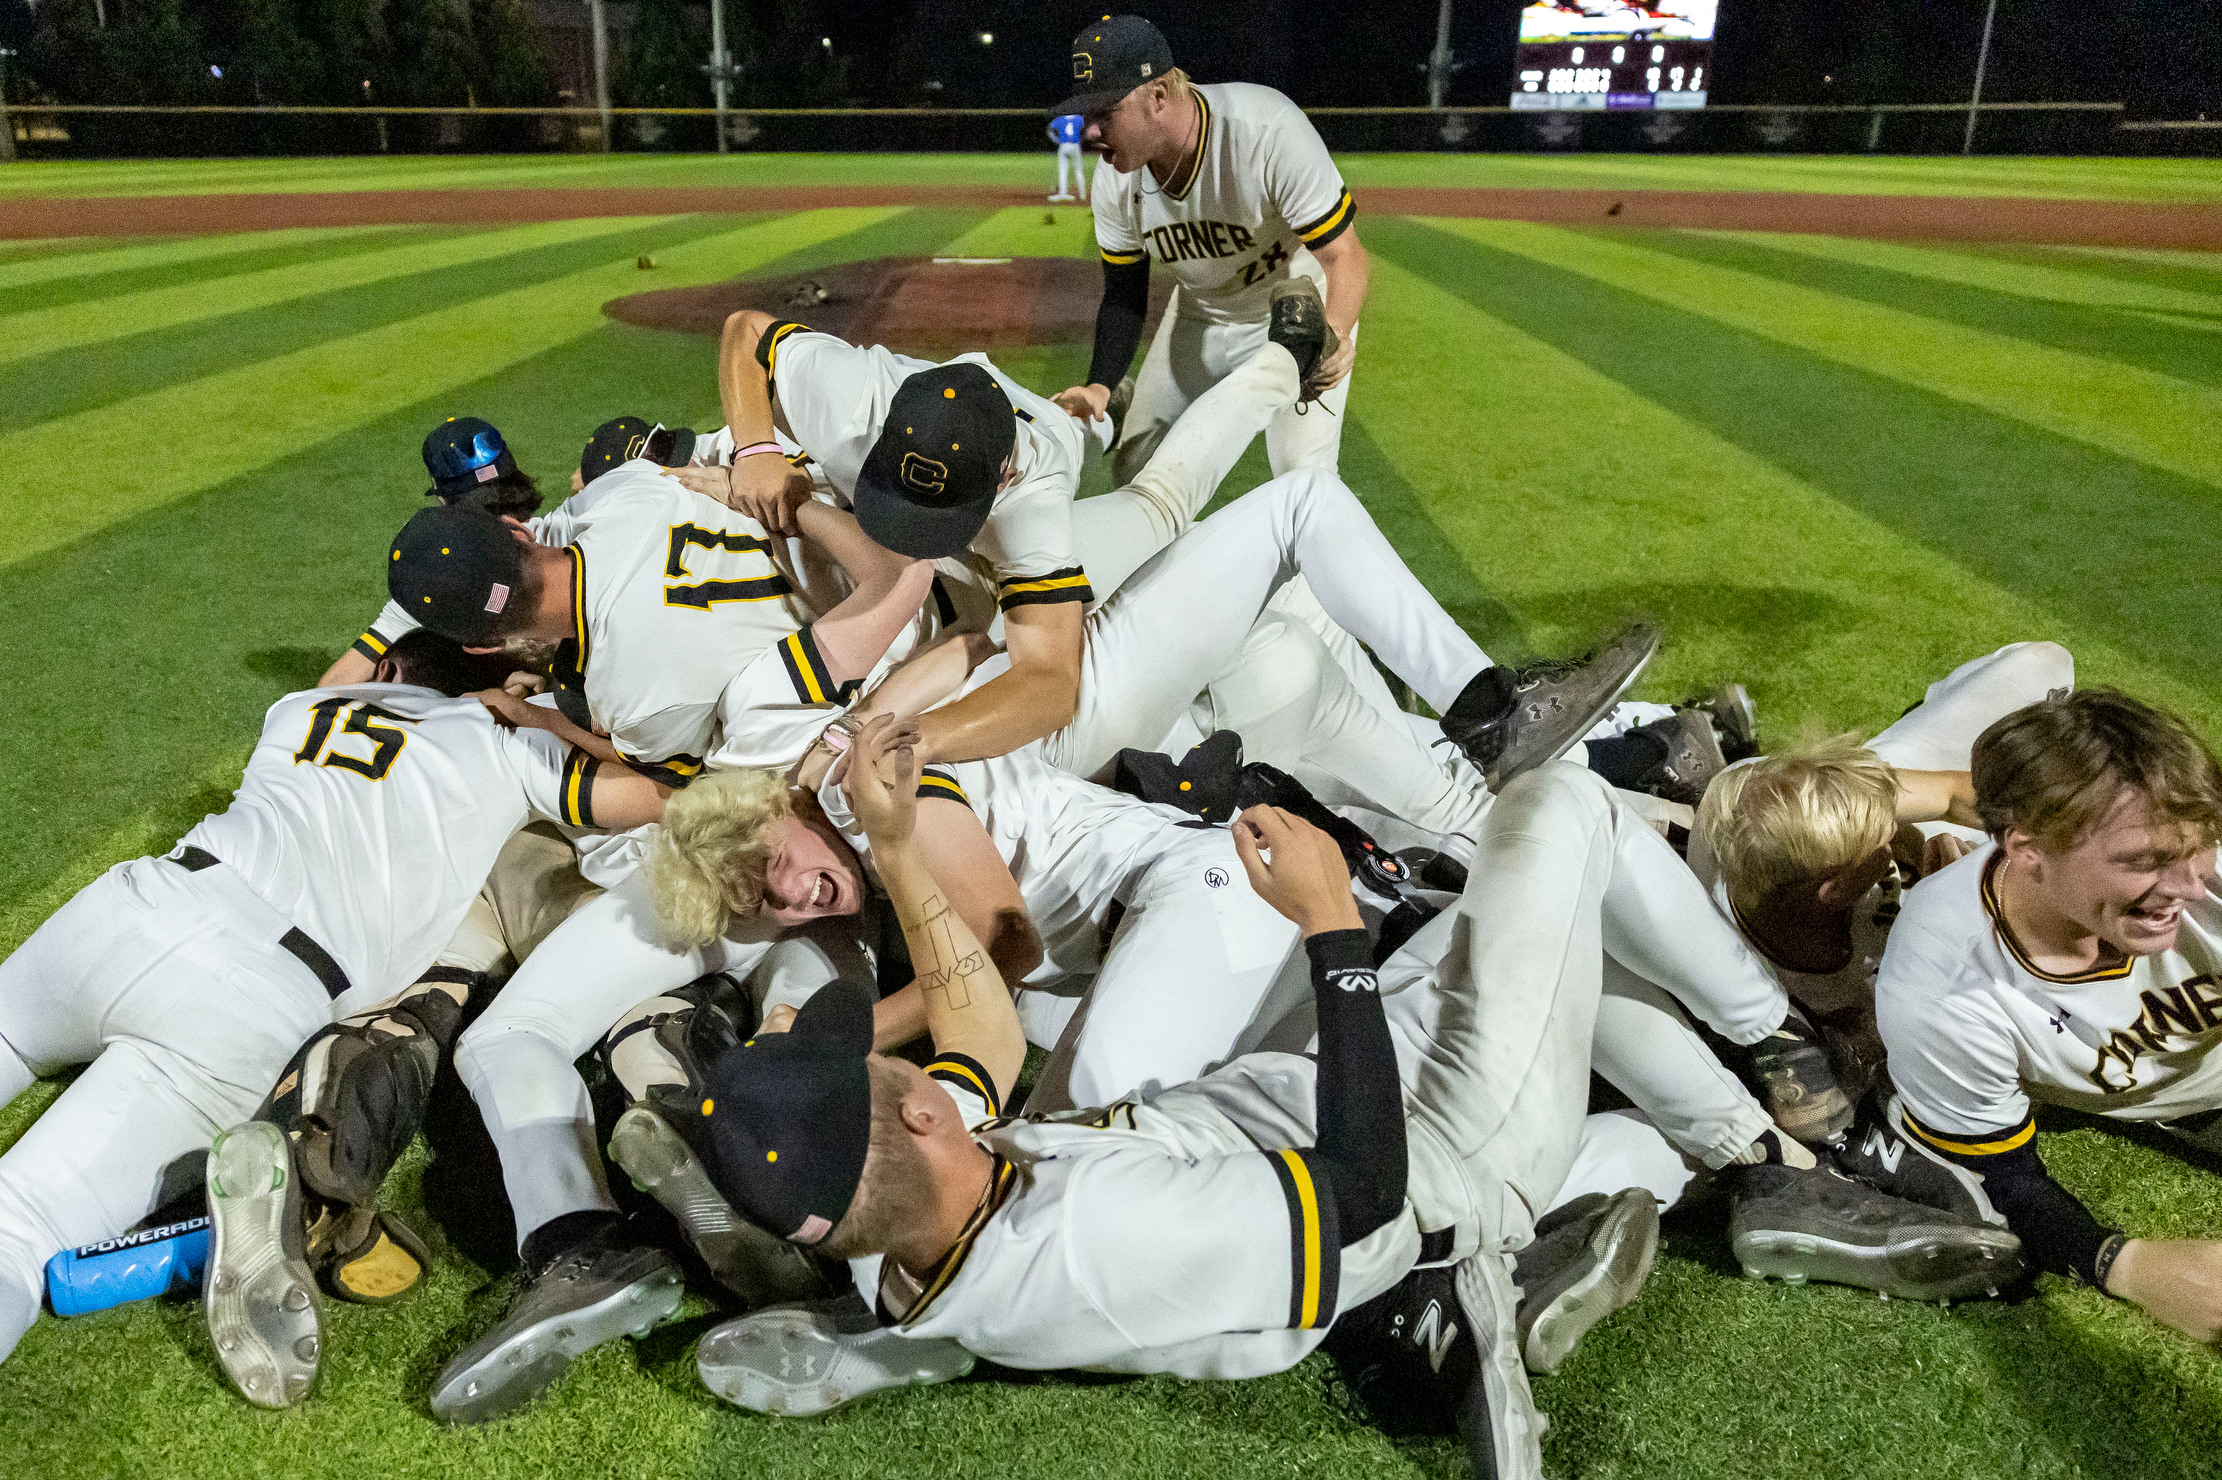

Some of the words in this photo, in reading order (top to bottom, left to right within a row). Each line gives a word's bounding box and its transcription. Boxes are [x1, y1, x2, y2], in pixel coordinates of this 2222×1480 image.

[1143, 219, 1257, 264] ORNER
[900, 451, 948, 495] C
[664, 520, 795, 612] 17
[292, 697, 427, 782] 15
